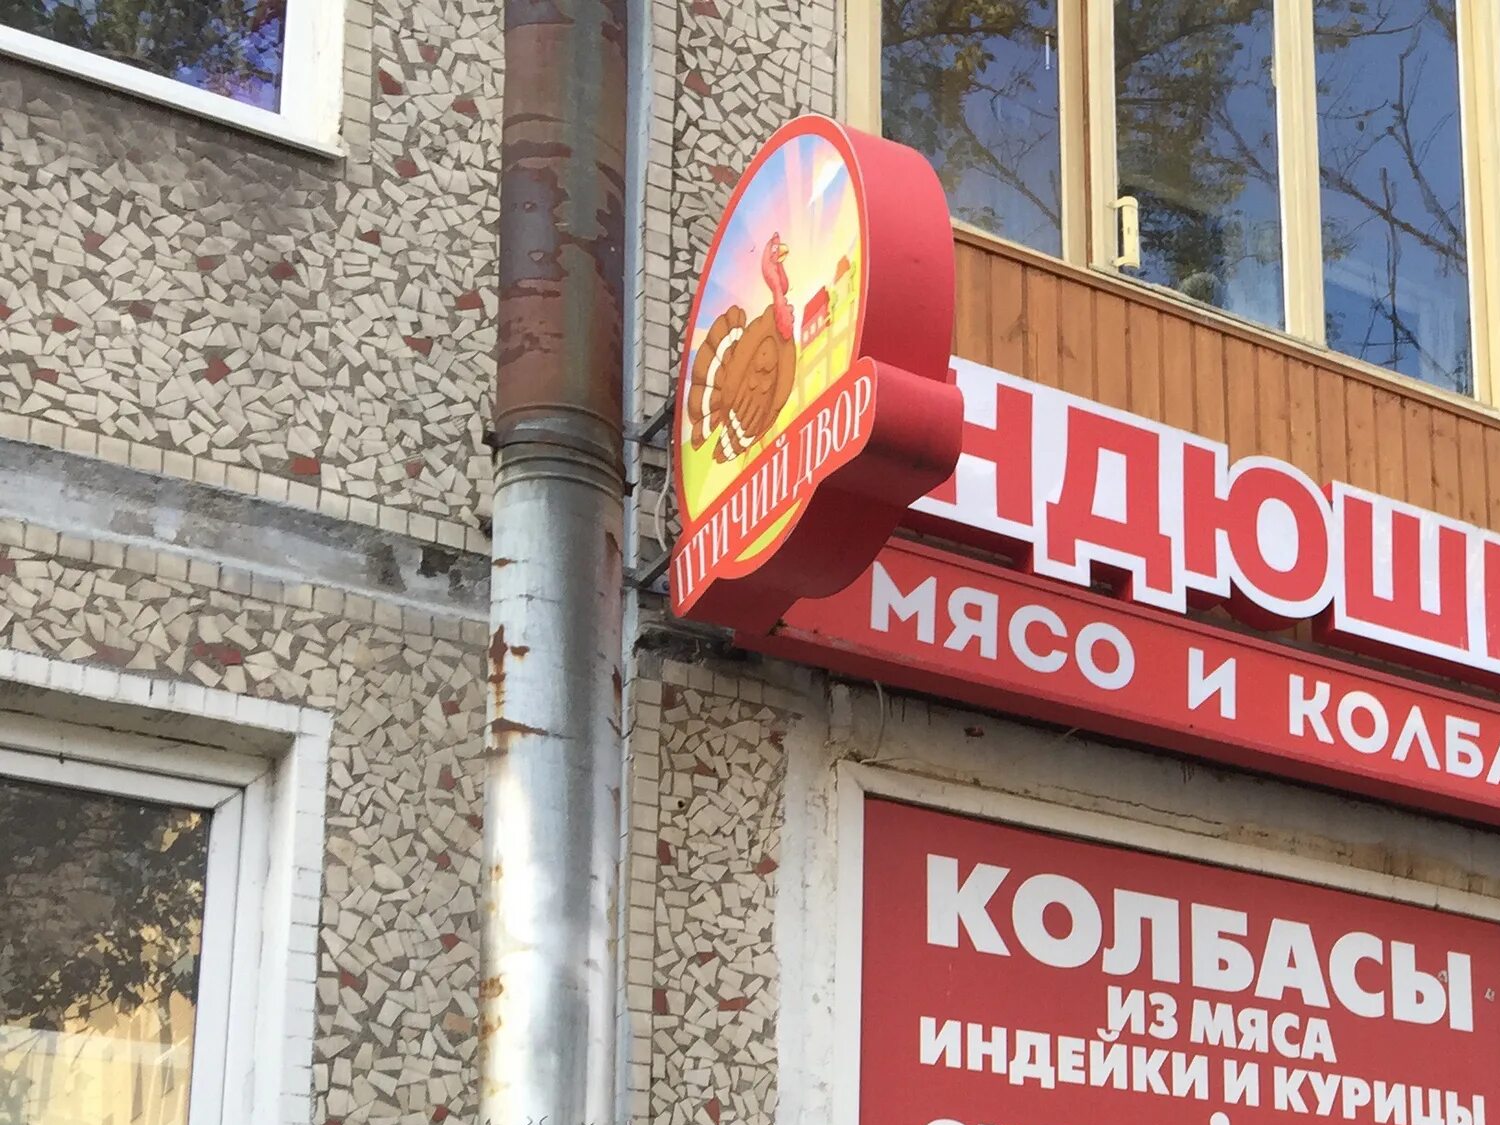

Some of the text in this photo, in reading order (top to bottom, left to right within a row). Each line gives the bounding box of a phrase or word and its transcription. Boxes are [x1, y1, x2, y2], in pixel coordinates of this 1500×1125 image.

[674, 375, 872, 607] ПТИЧИЙ ДВОР
[870, 561, 1136, 691] МЯСО
[1187, 647, 1237, 719] И
[926, 853, 1474, 1033] КОЛБАСЫ
[919, 1016, 1208, 1100] ИНДЕЙКИ
[1224, 1061, 1260, 1107] И
[1107, 985, 1337, 1063] ИЗ МЯСА
